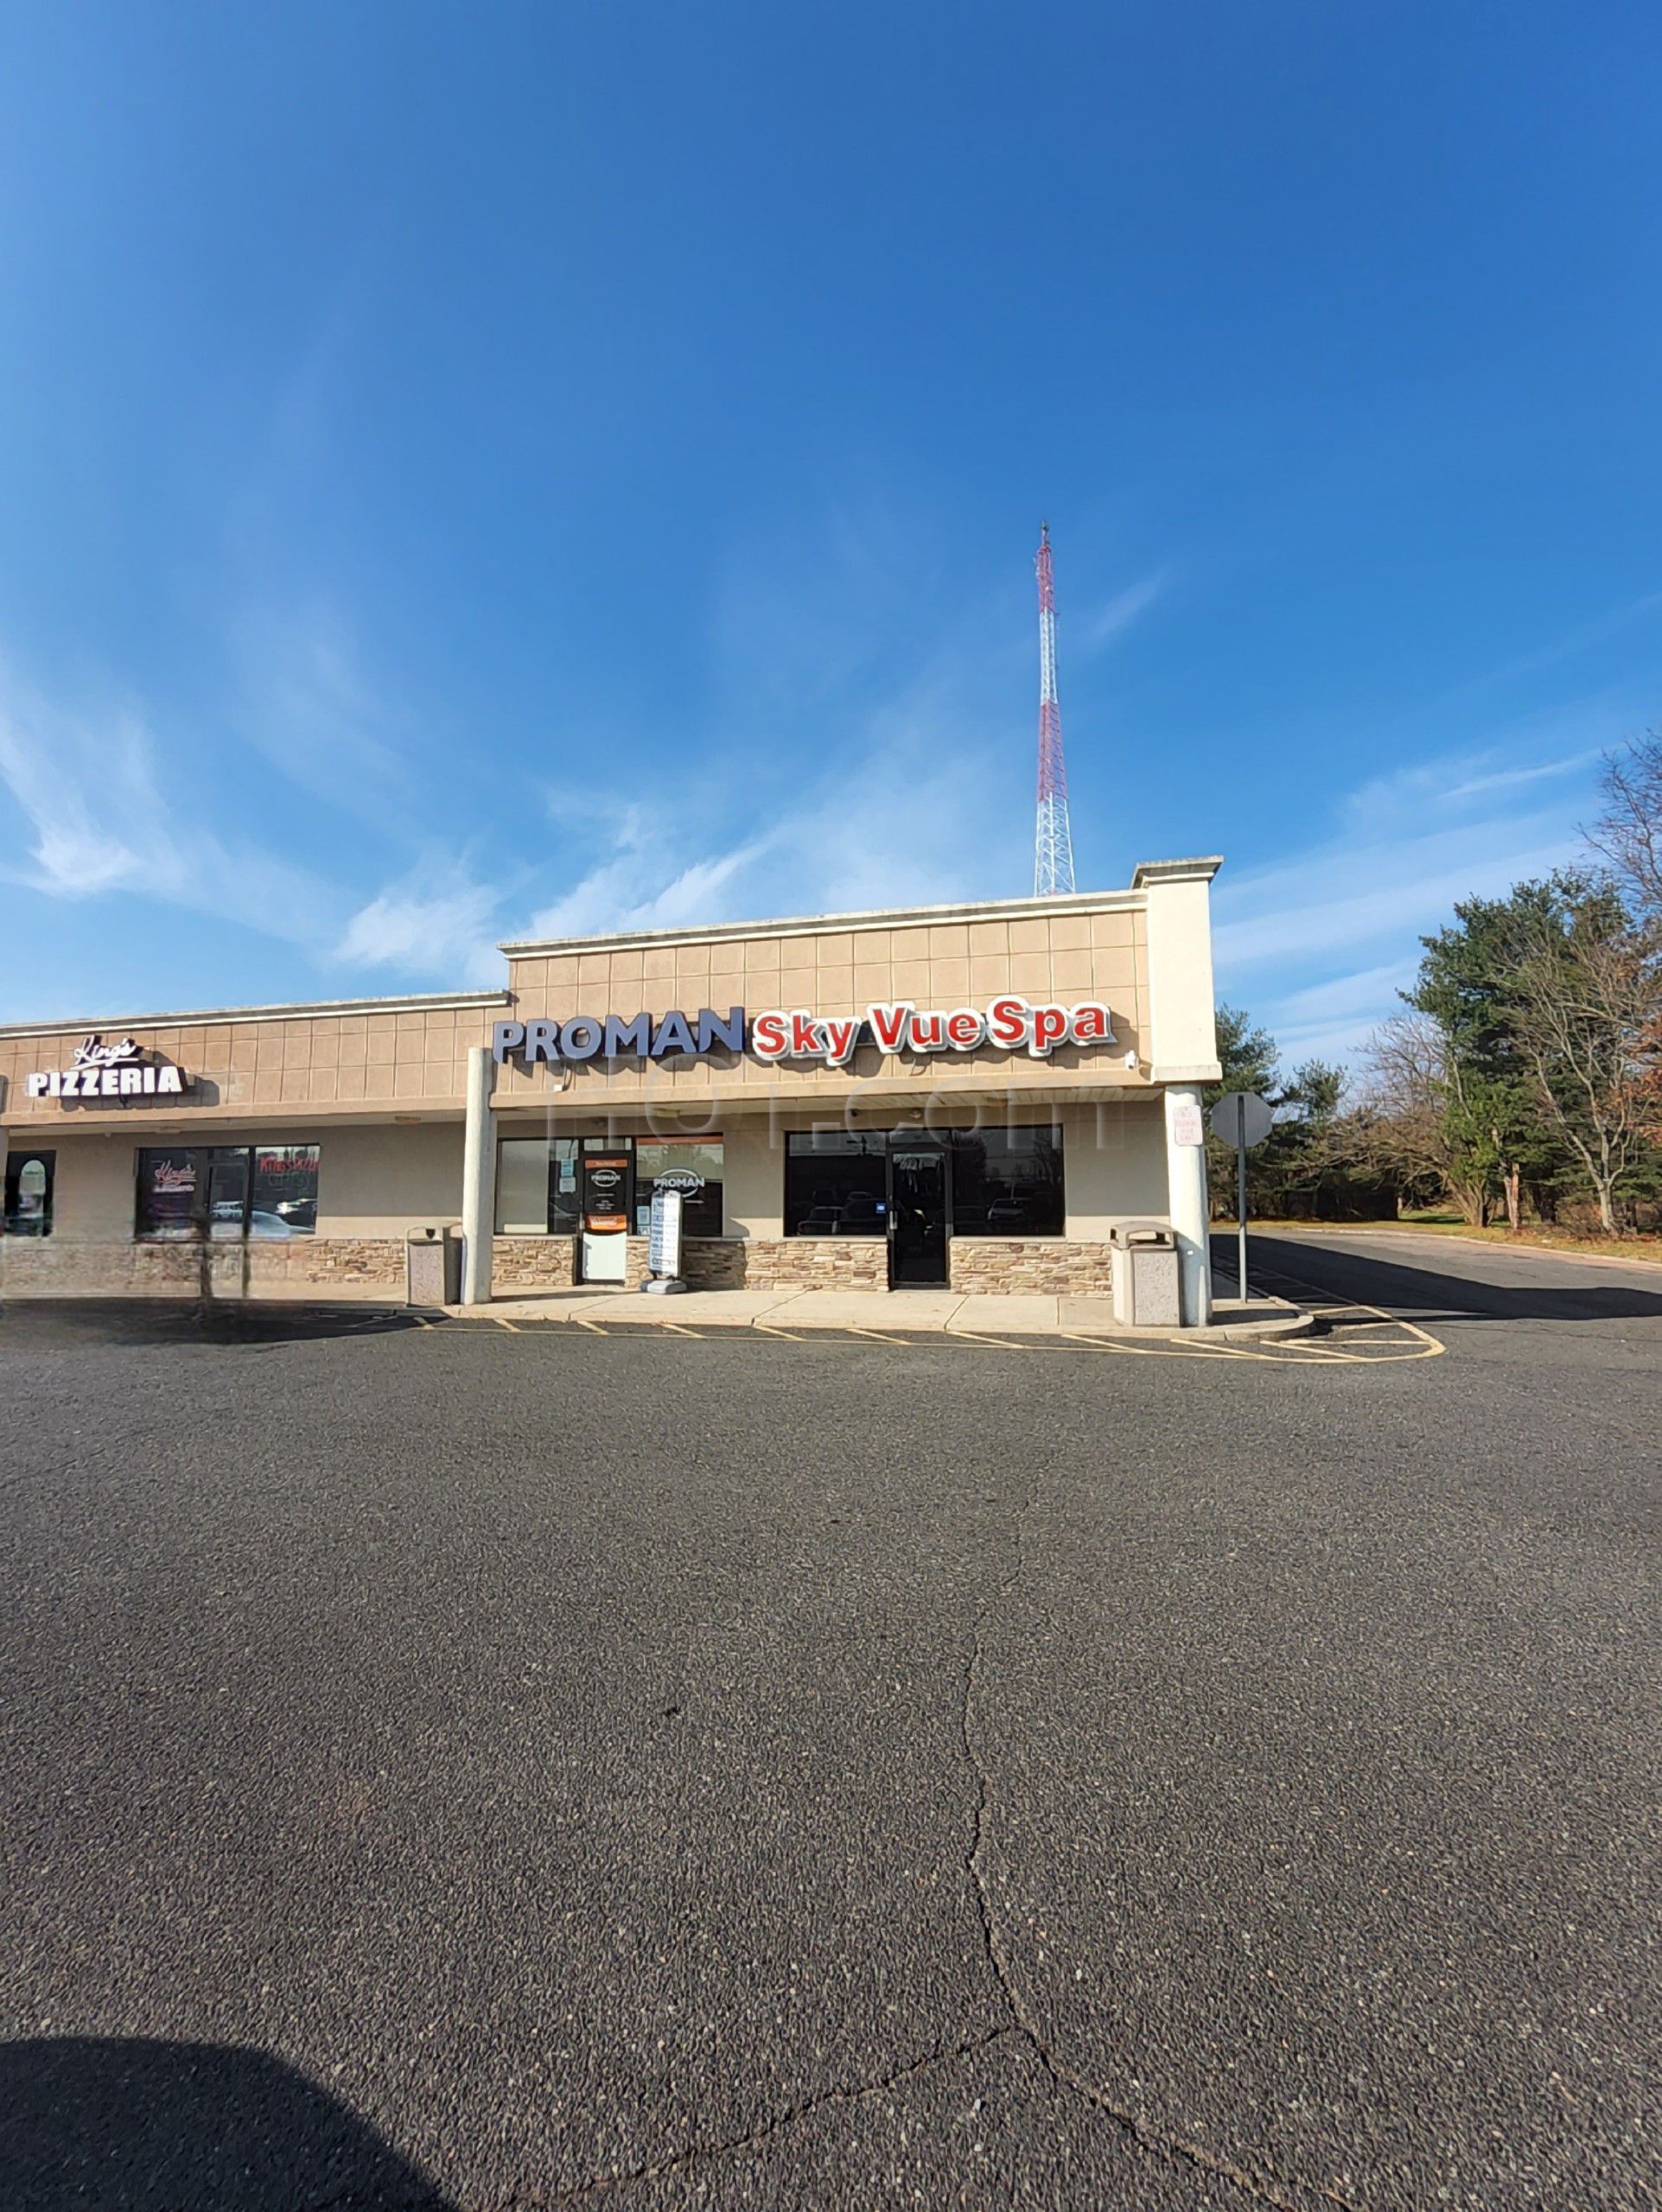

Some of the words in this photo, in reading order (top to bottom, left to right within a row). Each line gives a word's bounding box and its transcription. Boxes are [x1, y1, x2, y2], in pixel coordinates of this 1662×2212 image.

[492, 1007, 746, 1065] PROMAN
[753, 1010, 860, 1065] Sky
[868, 1002, 984, 1054] Vue
[988, 995, 1113, 1056] Spa
[72, 1034, 138, 1068] King's
[27, 1065, 183, 1097] PIZZERIA
[653, 1176, 705, 1188] PROMAN
